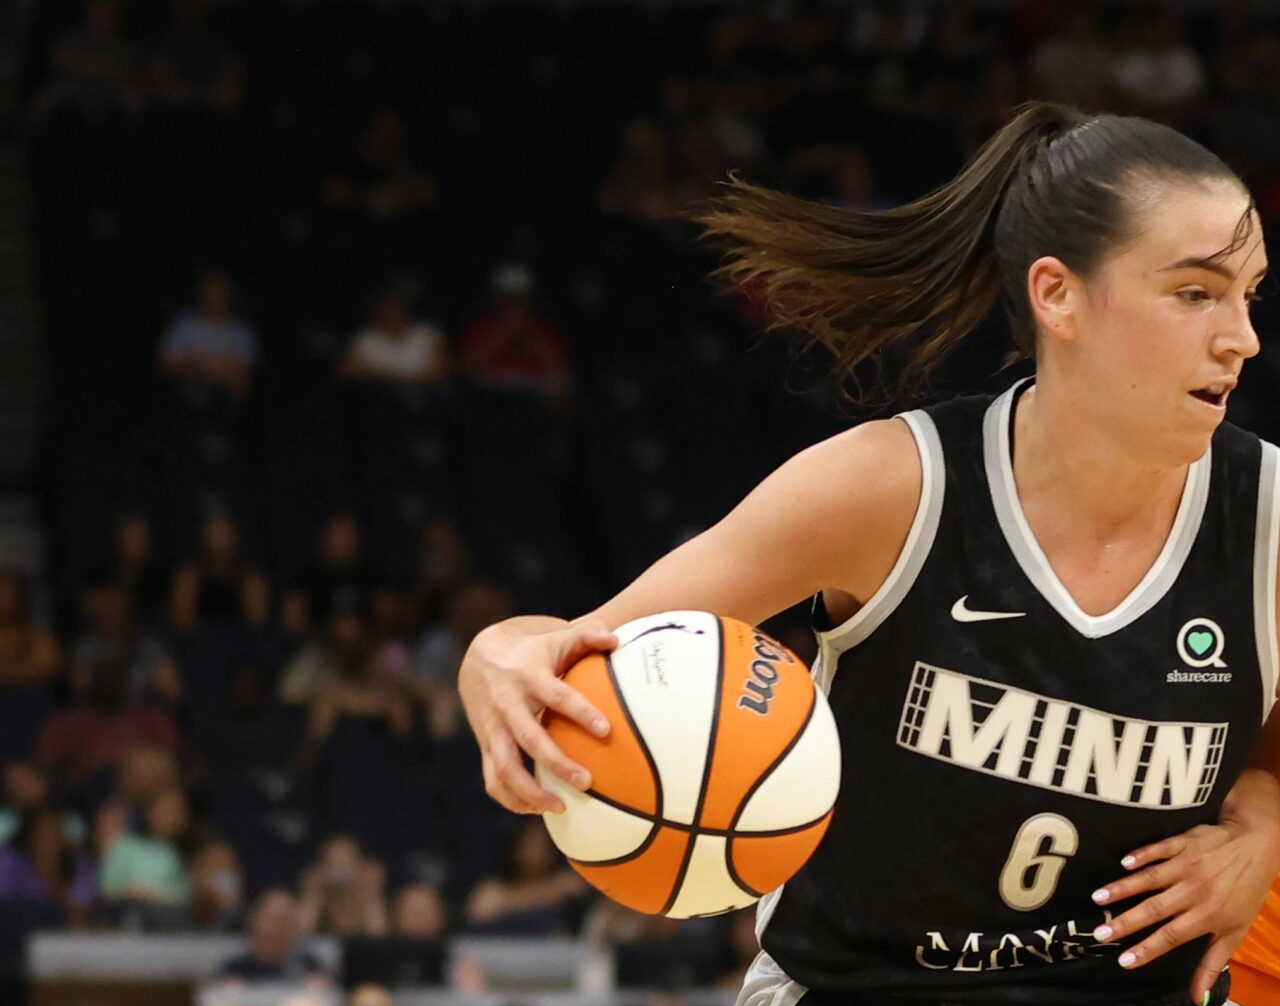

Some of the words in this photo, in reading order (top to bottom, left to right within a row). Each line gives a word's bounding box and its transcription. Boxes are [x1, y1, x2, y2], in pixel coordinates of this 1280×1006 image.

[1166, 669, 1232, 683] sharecare
[908, 667, 1220, 808] MINN
[999, 811, 1079, 912] 6
